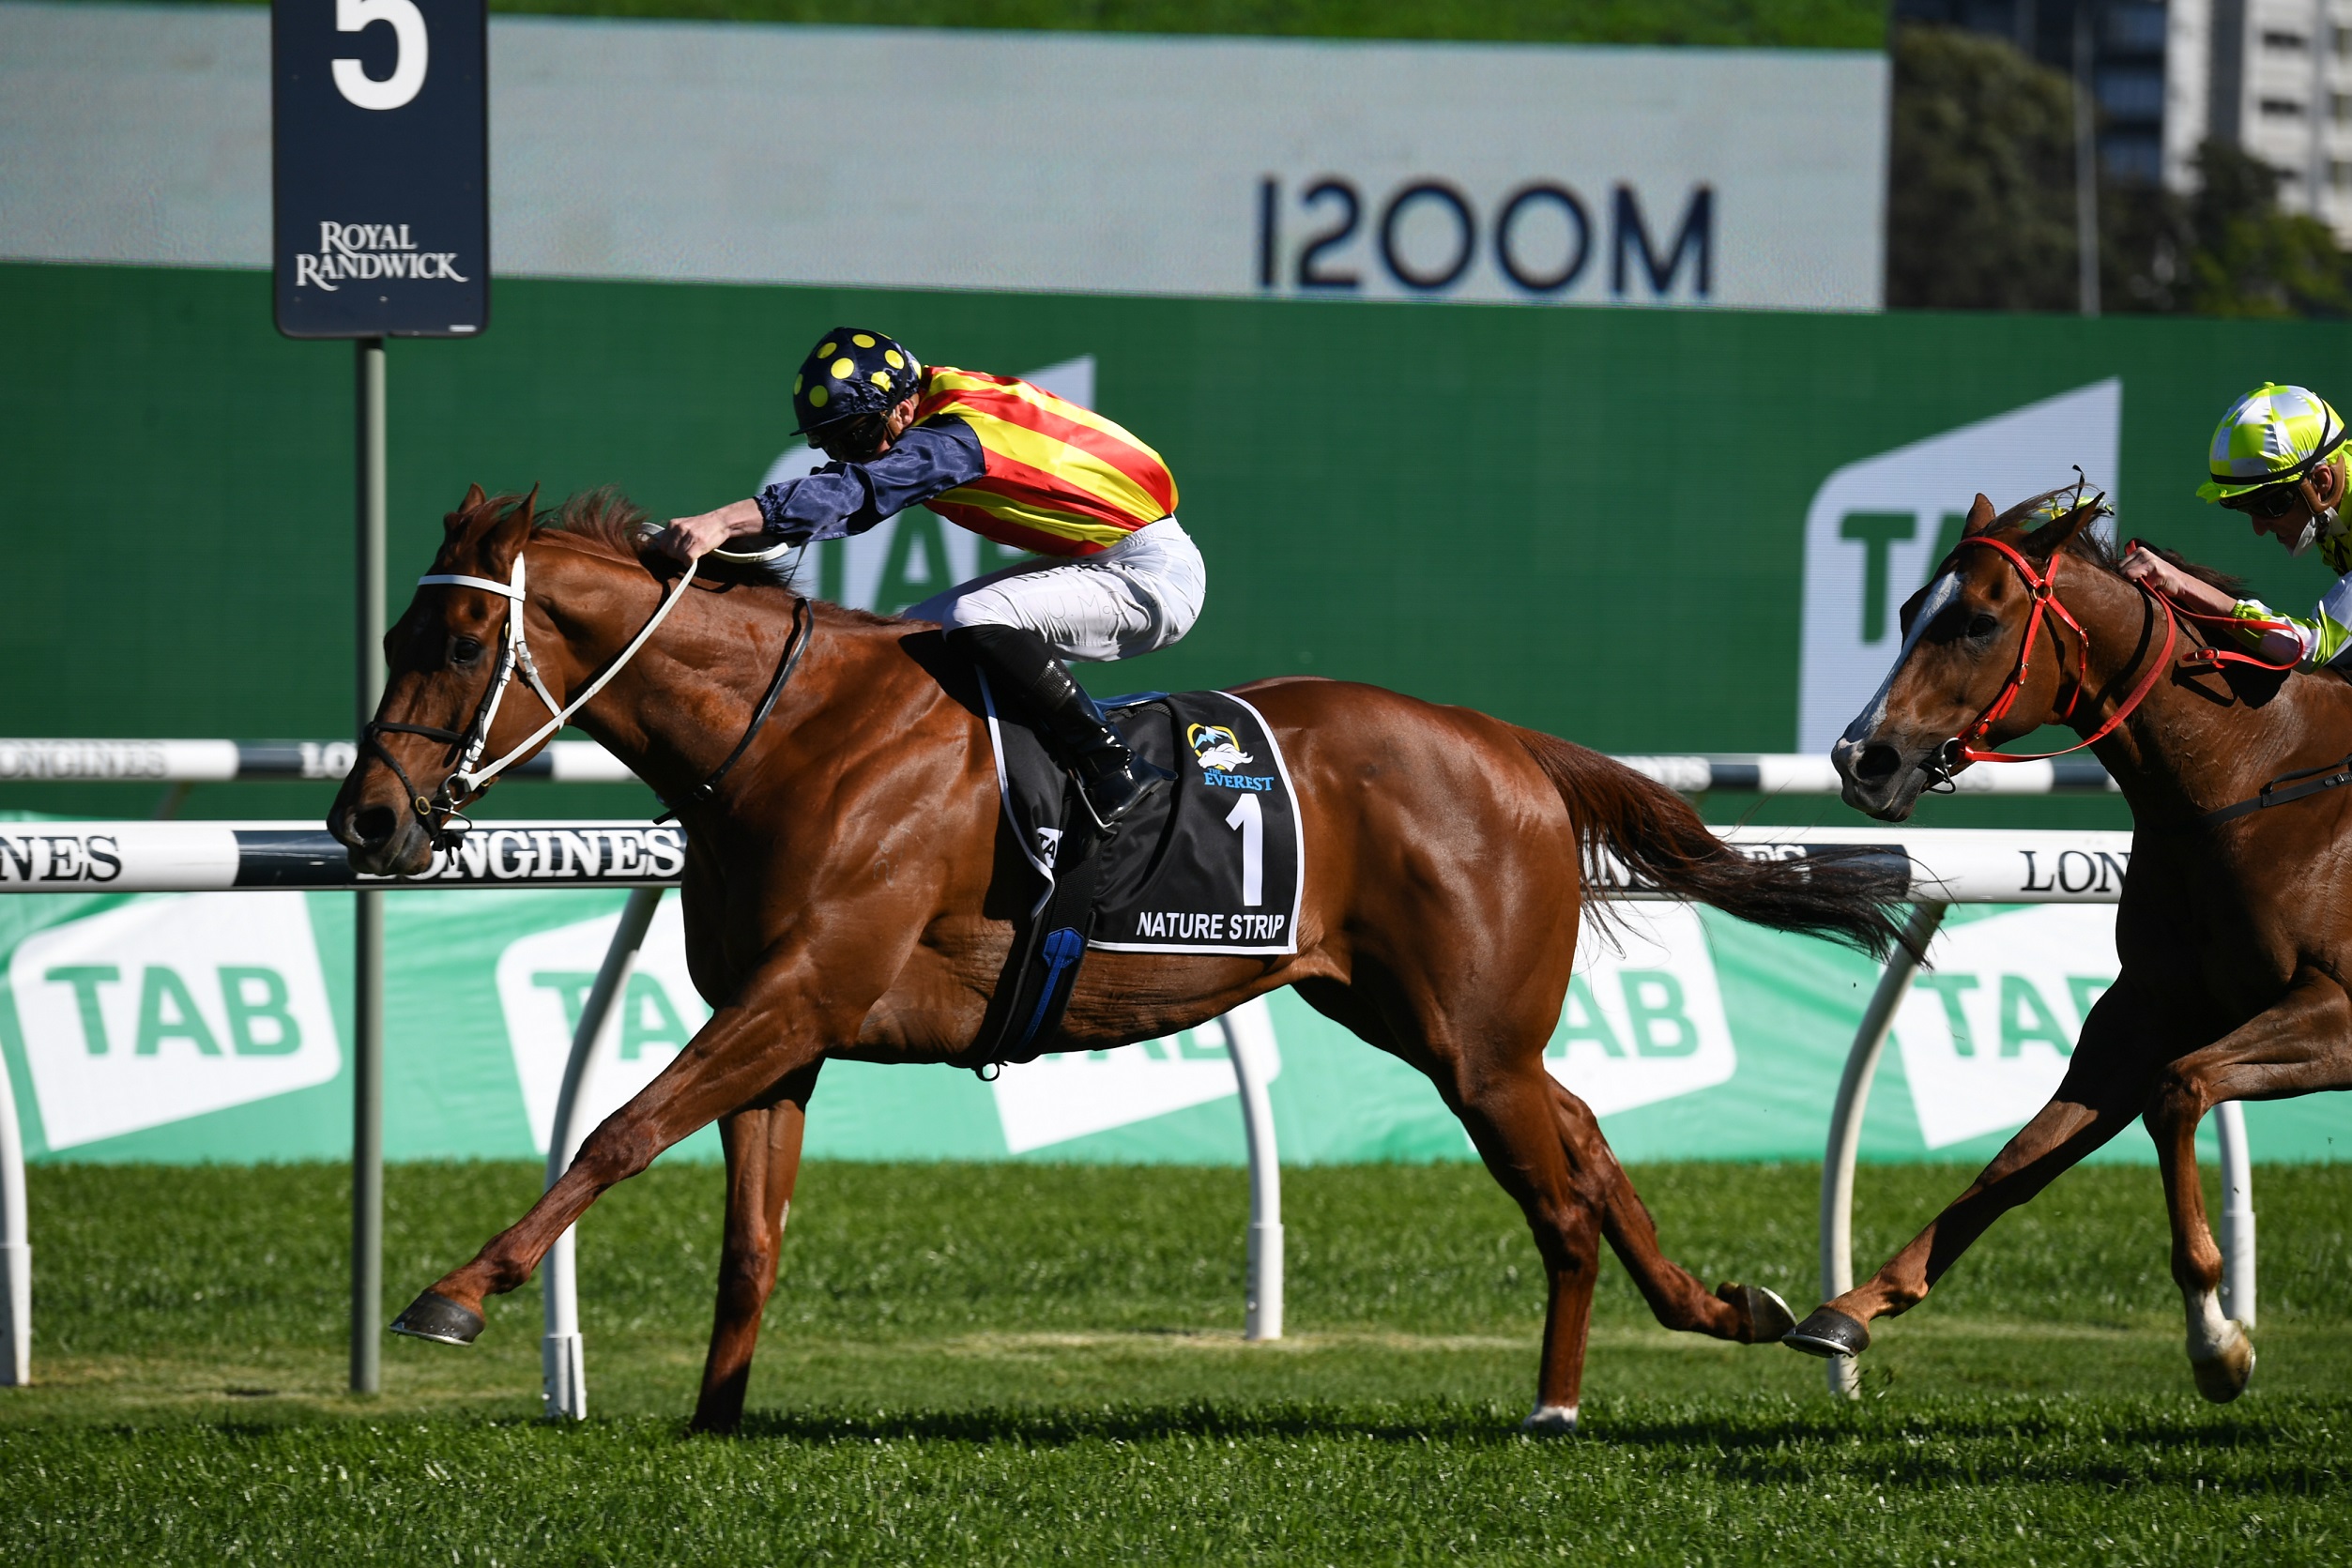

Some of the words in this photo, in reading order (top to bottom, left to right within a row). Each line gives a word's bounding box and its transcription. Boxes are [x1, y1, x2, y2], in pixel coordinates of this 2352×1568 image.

[331, 0, 429, 111] 5
[319, 221, 419, 258] ROYAL
[1258, 175, 1714, 297] 1200M
[296, 253, 469, 292] RANDWICK
[1204, 772, 1275, 791] EVEREST
[356, 830, 686, 881] NGINES
[1225, 793, 1264, 906] 1
[1136, 911, 1225, 939] NATURE
[1229, 914, 1285, 940] STRIP
[45, 965, 303, 1058] TAB
